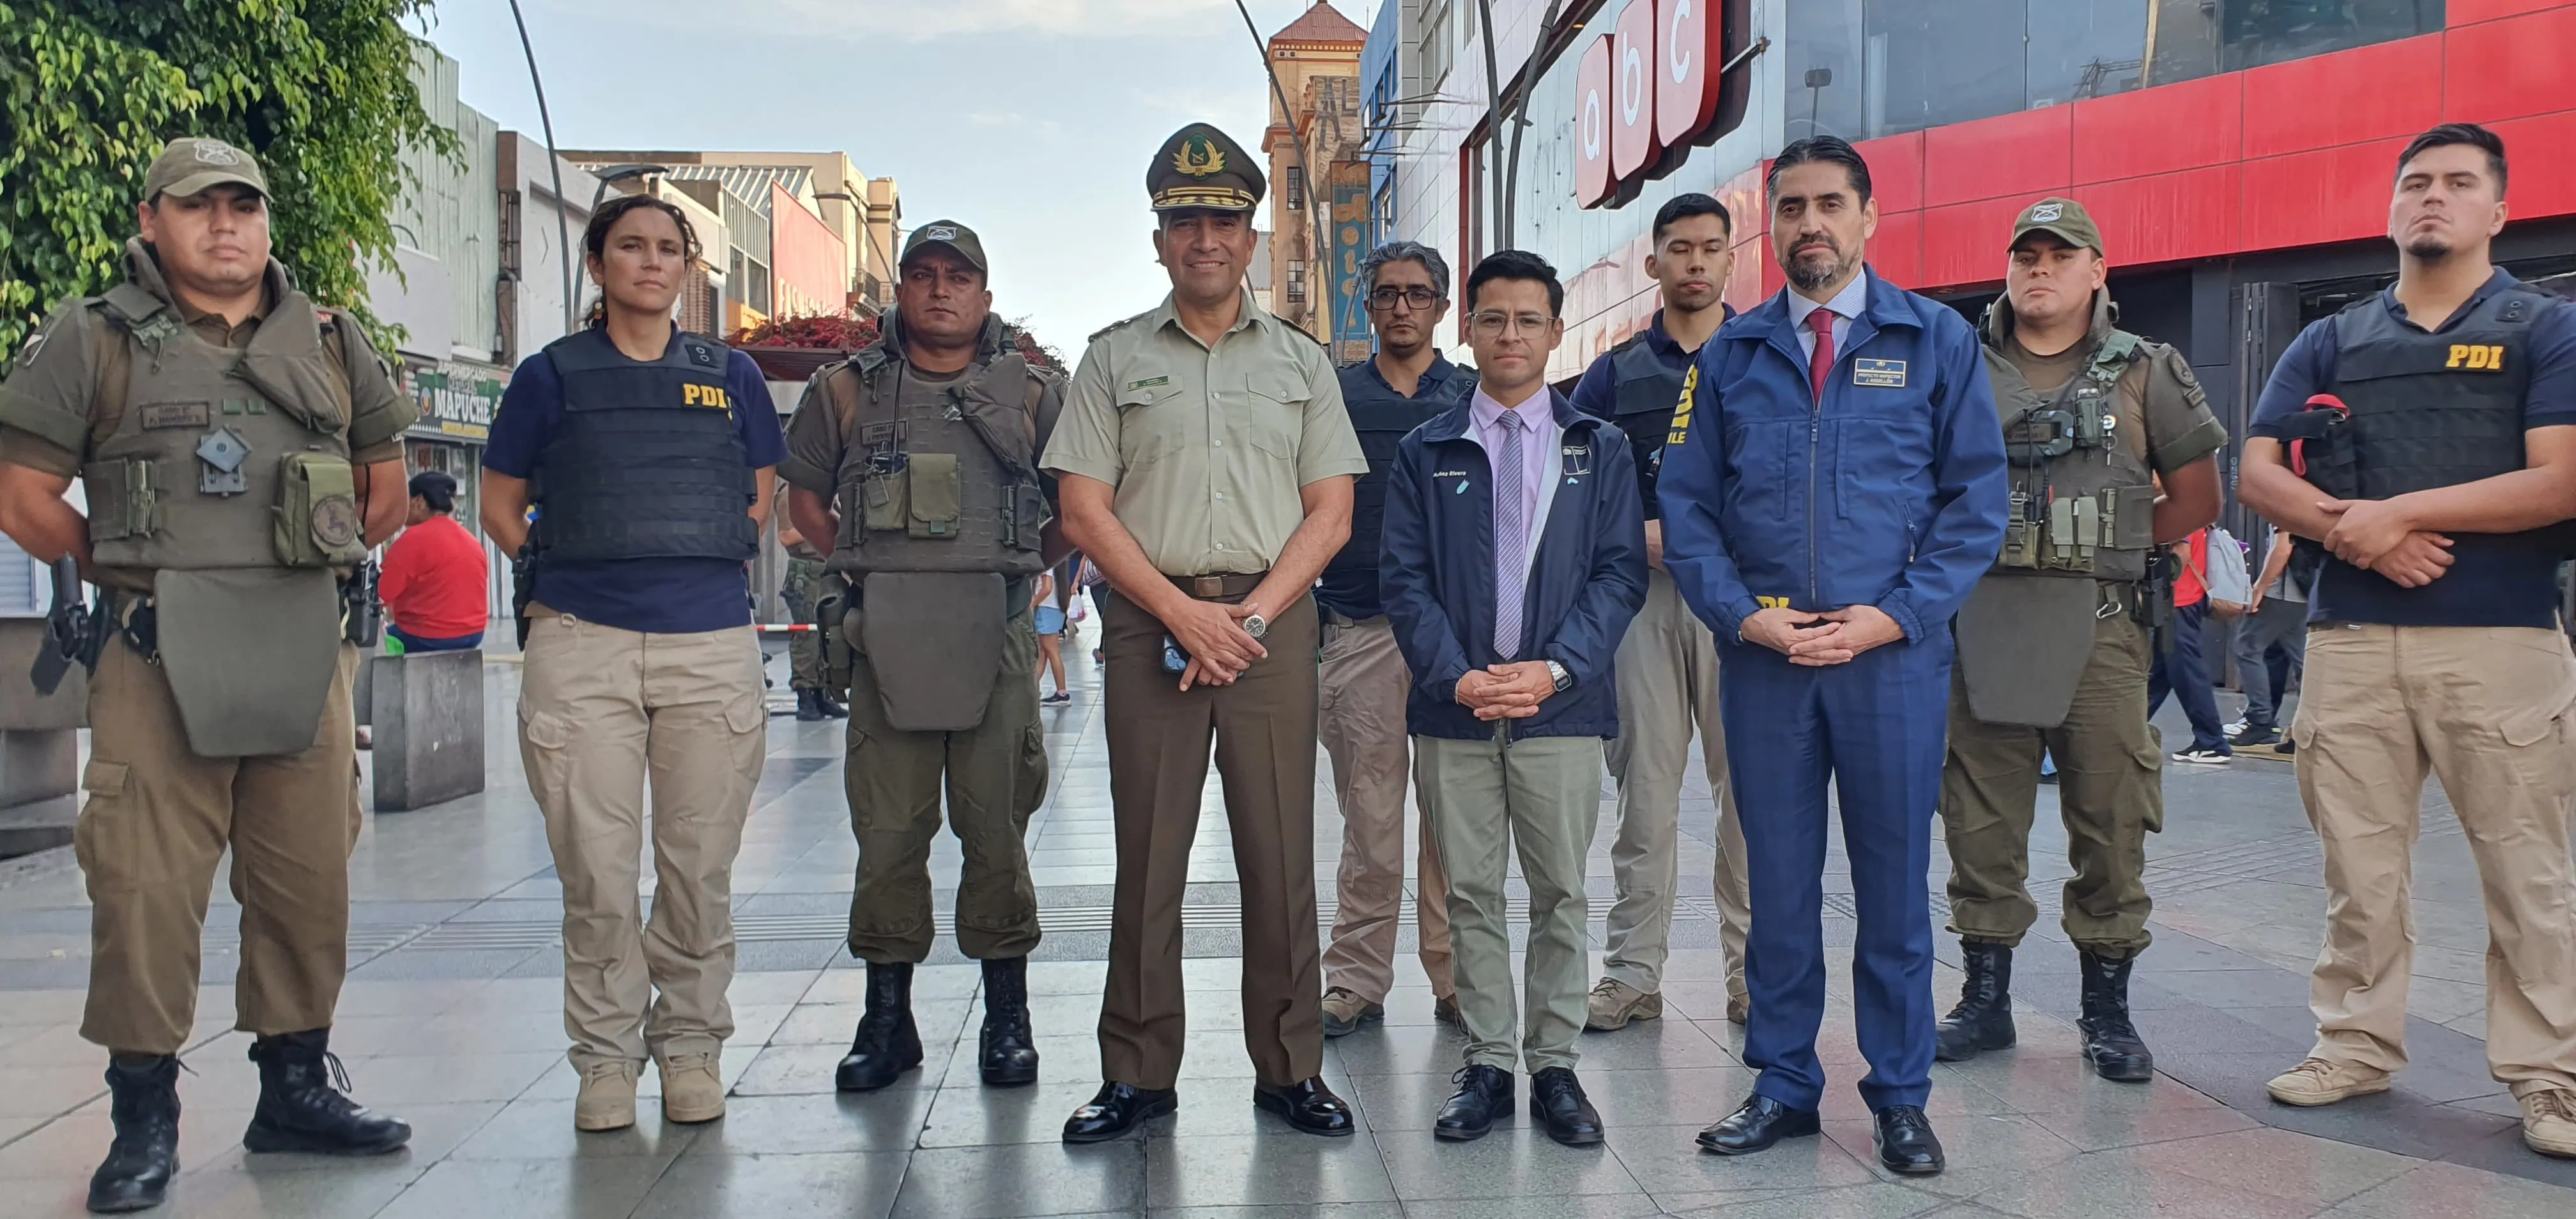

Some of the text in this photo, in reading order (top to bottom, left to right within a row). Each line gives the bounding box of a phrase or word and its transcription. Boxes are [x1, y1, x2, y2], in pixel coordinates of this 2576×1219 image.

[1584, 0, 1690, 160] abc
[2446, 344, 2504, 369] PDI
[434, 388, 491, 424] MAPUCHE
[683, 383, 727, 409] PDI
[1667, 431, 1687, 444] ILE
